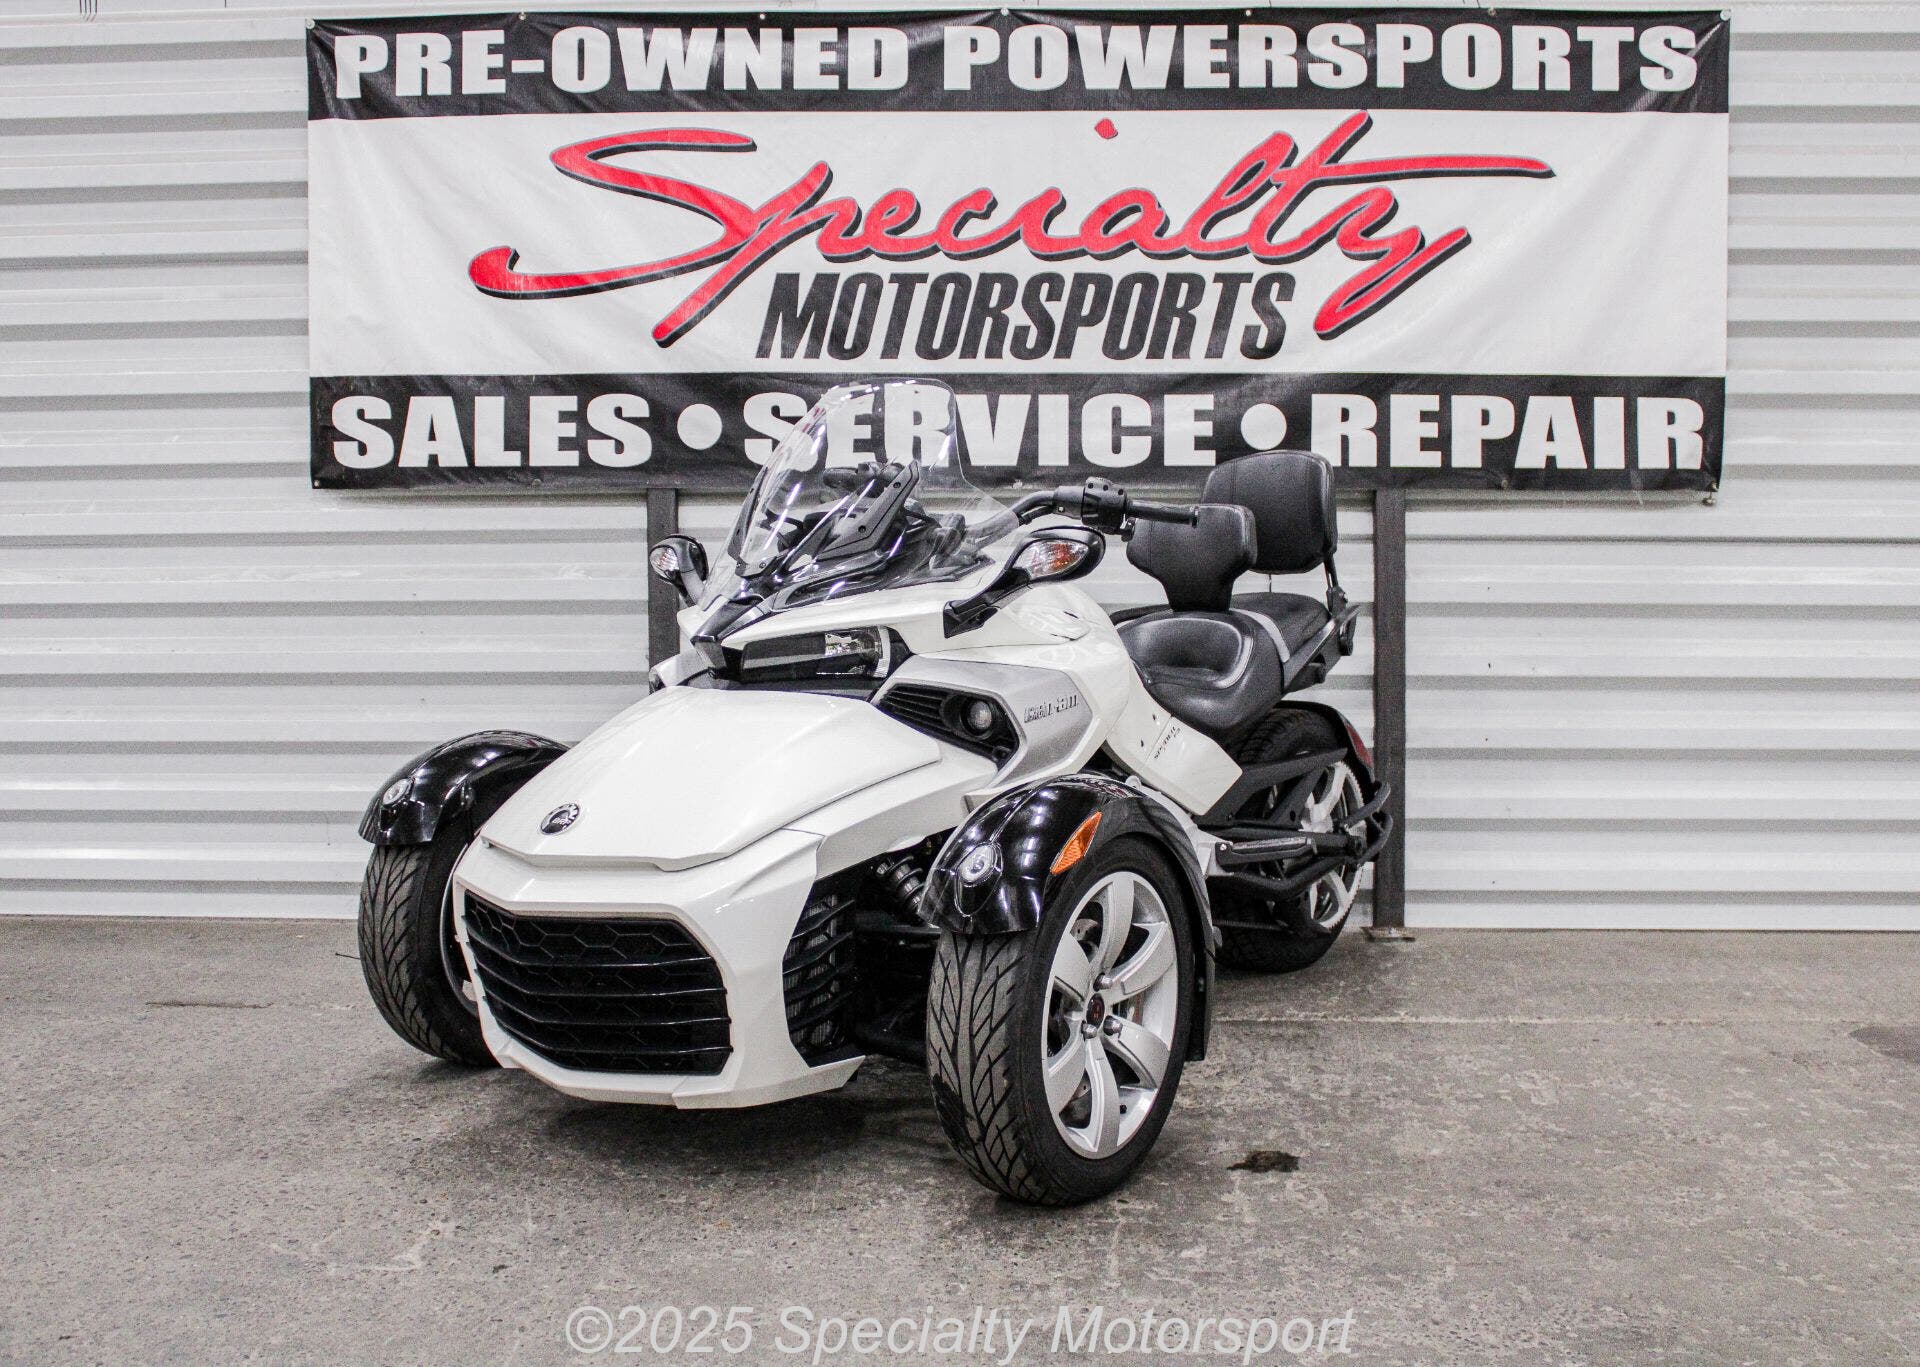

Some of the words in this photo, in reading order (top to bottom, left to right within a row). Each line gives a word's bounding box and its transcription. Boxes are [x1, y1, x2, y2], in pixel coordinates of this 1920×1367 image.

[335, 27, 908, 98] PRE-OWNED
[944, 23, 1697, 92] POWERSPORTS
[469, 110, 1556, 347] Specialty
[755, 271, 1296, 361] MOTORSPORTS
[332, 394, 653, 468] SALES
[742, 392, 1217, 469] SERVICE
[1311, 393, 1704, 470] REPAIR
